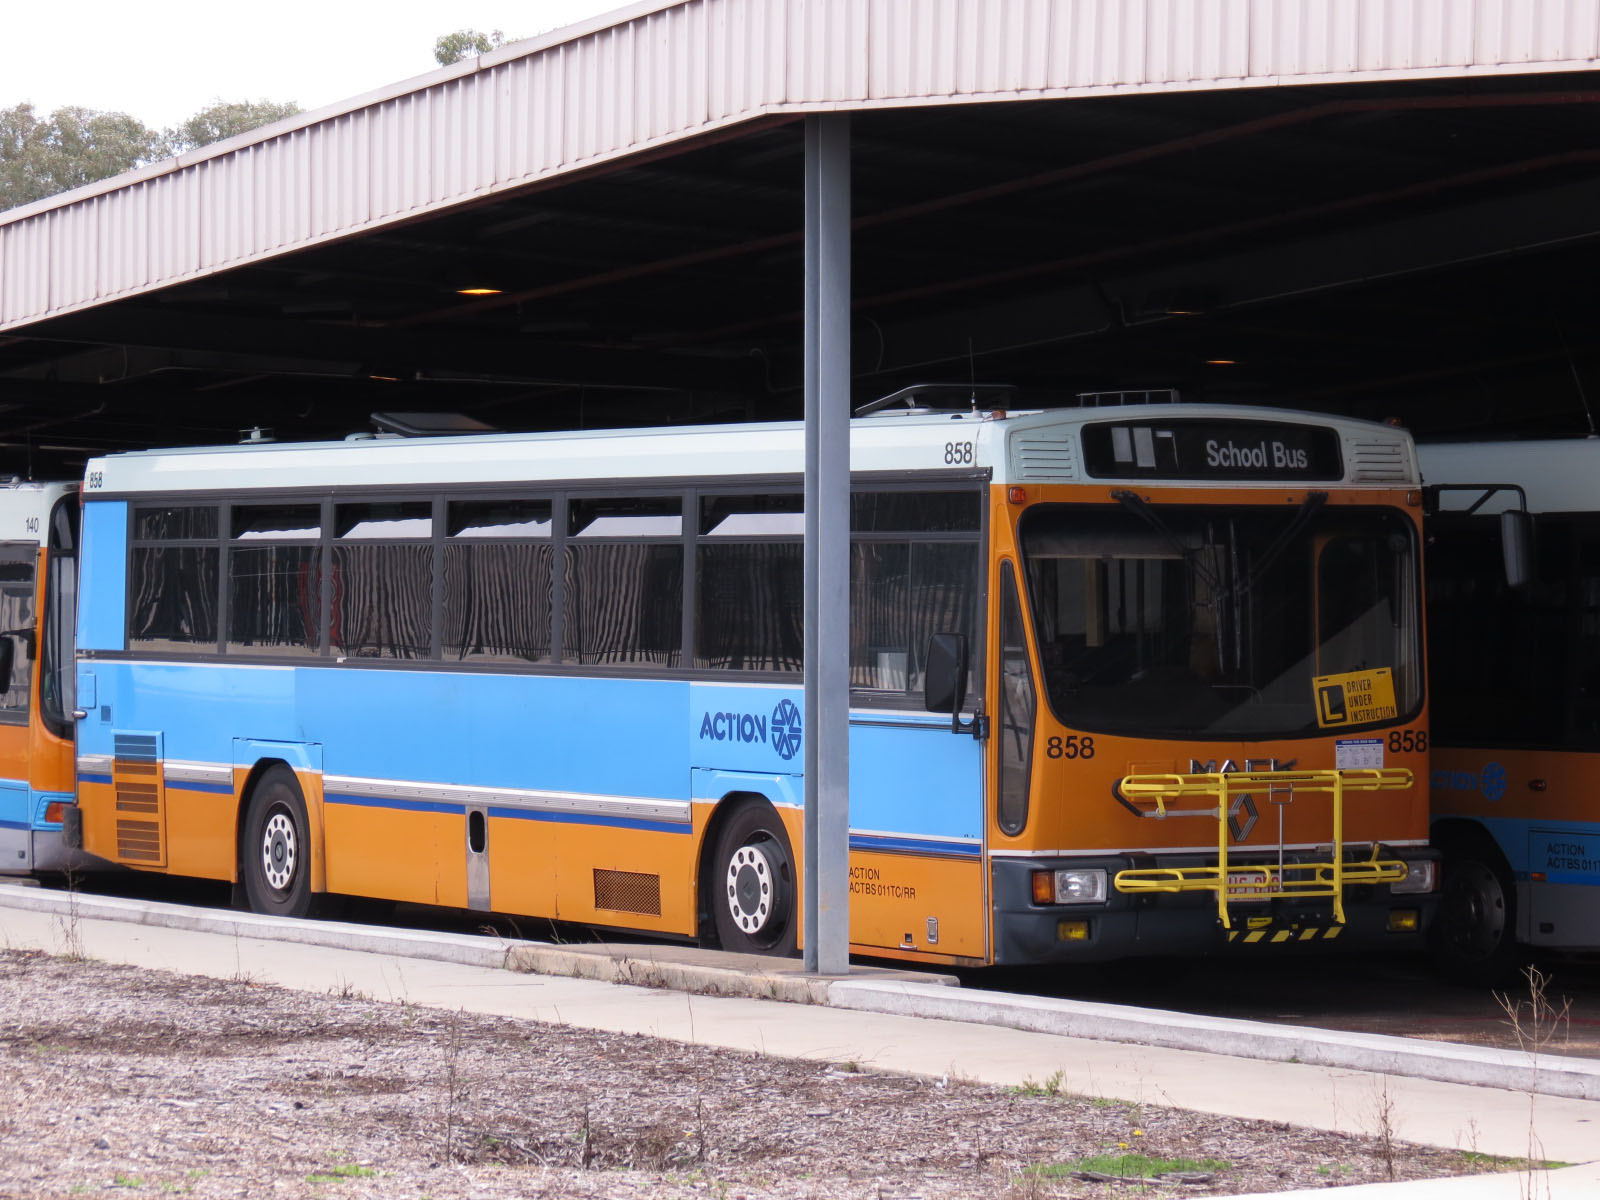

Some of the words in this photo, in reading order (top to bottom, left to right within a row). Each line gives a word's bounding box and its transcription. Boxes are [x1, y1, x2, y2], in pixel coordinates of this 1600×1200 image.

[944, 441, 973, 464] 858
[1206, 440, 1268, 468] School
[1272, 441, 1308, 468] Bus
[89, 471, 103, 488] 858
[26, 517, 39, 533] 140
[1346, 679, 1372, 693] DRIVER
[1348, 694, 1373, 708] UNDER
[1350, 706, 1396, 722] INSTRUCTION
[700, 711, 767, 744] ACTION
[1046, 735, 1095, 759] 858
[1388, 730, 1428, 753] 858
[1430, 770, 1479, 791] CTION
[1546, 842, 1585, 856] ACTION
[849, 866, 880, 880] ACTION
